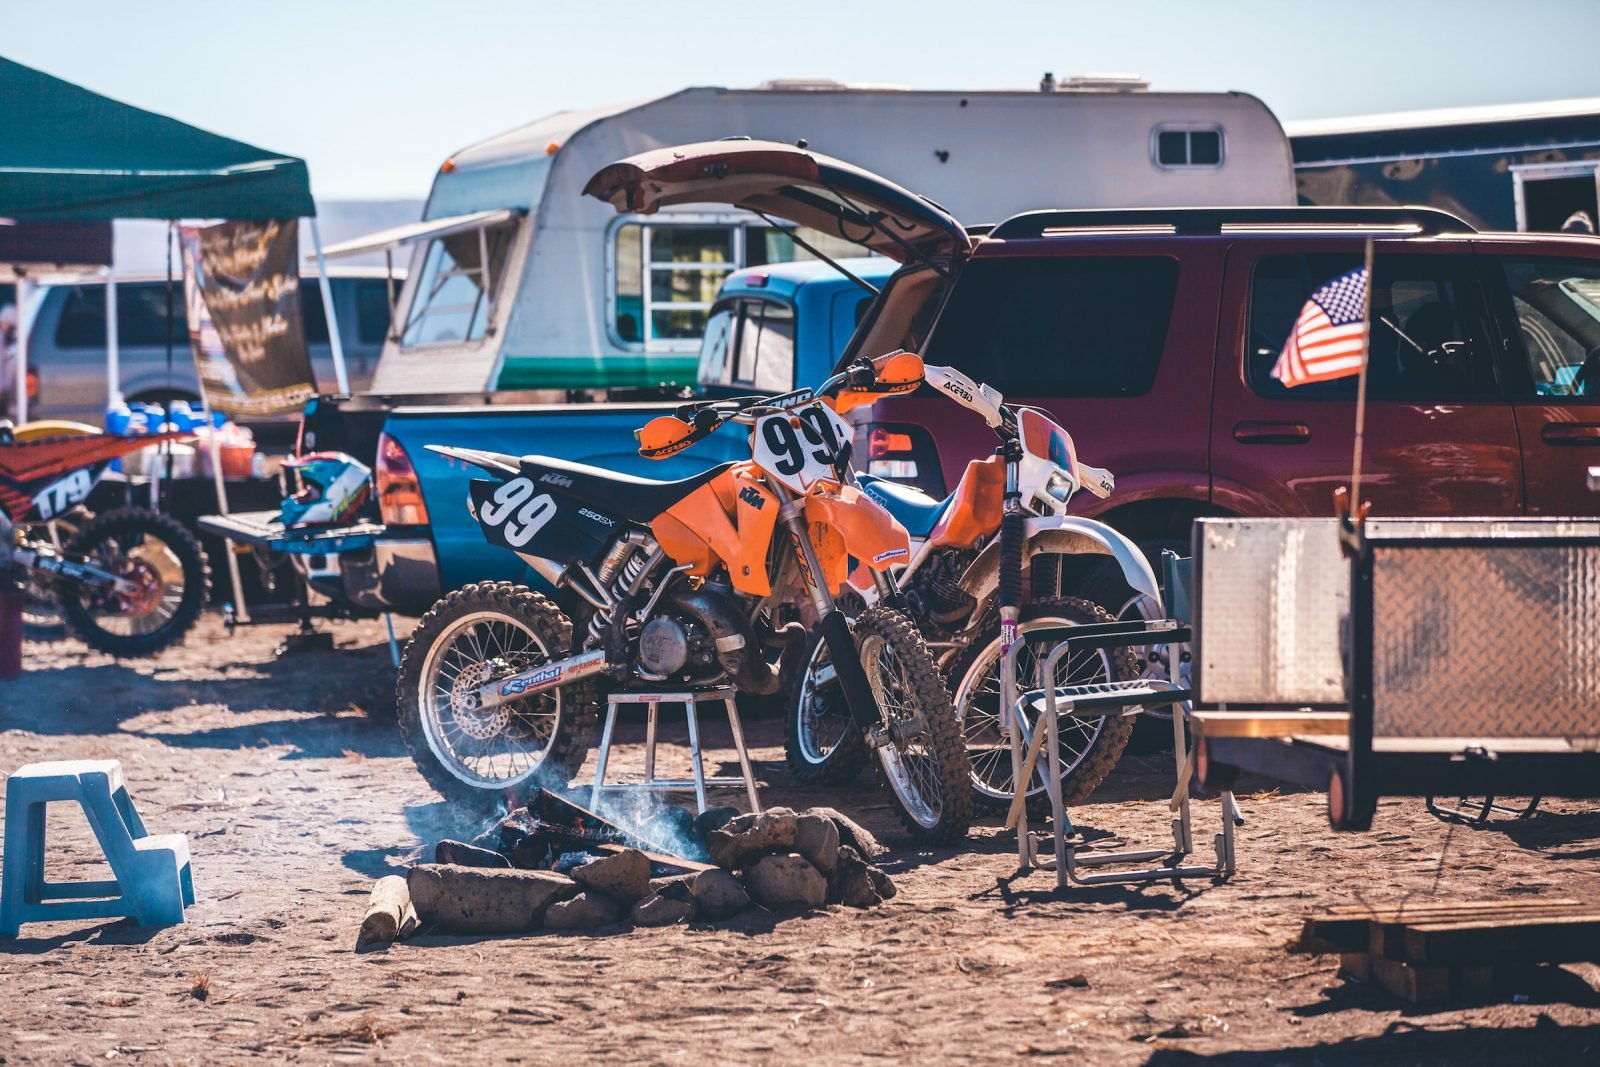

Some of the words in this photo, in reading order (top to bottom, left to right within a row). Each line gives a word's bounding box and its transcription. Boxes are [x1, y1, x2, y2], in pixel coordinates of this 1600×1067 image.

[943, 381, 973, 403] ACERBIS
[762, 407, 838, 476] 99
[539, 473, 574, 489] KTM
[739, 486, 766, 511] KTM
[480, 477, 558, 548] 99
[578, 507, 617, 527] 250SX
[501, 666, 562, 697] Renthal
